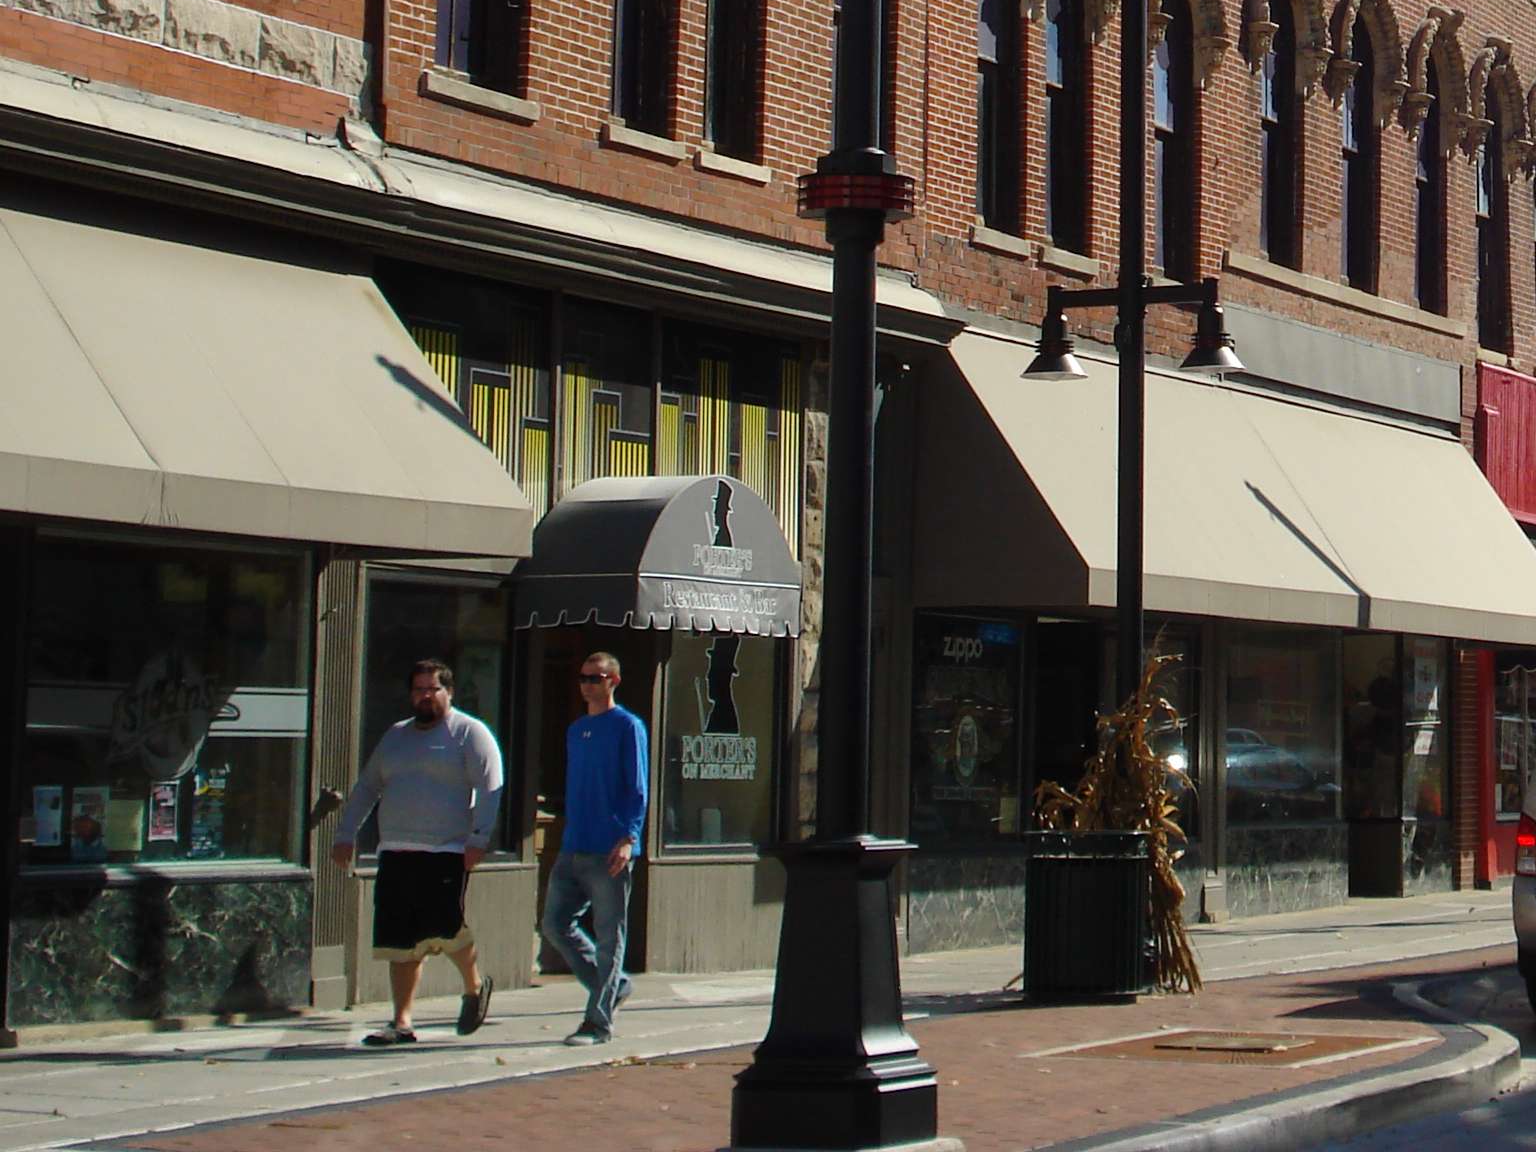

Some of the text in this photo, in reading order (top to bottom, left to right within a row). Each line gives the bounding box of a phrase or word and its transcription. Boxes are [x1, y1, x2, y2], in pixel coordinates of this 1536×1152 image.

[663, 581, 739, 612] Restaurant
[754, 589, 777, 615] Bar
[681, 735, 757, 763] PORTER'S
[682, 763, 756, 779] ON MERCHANT
